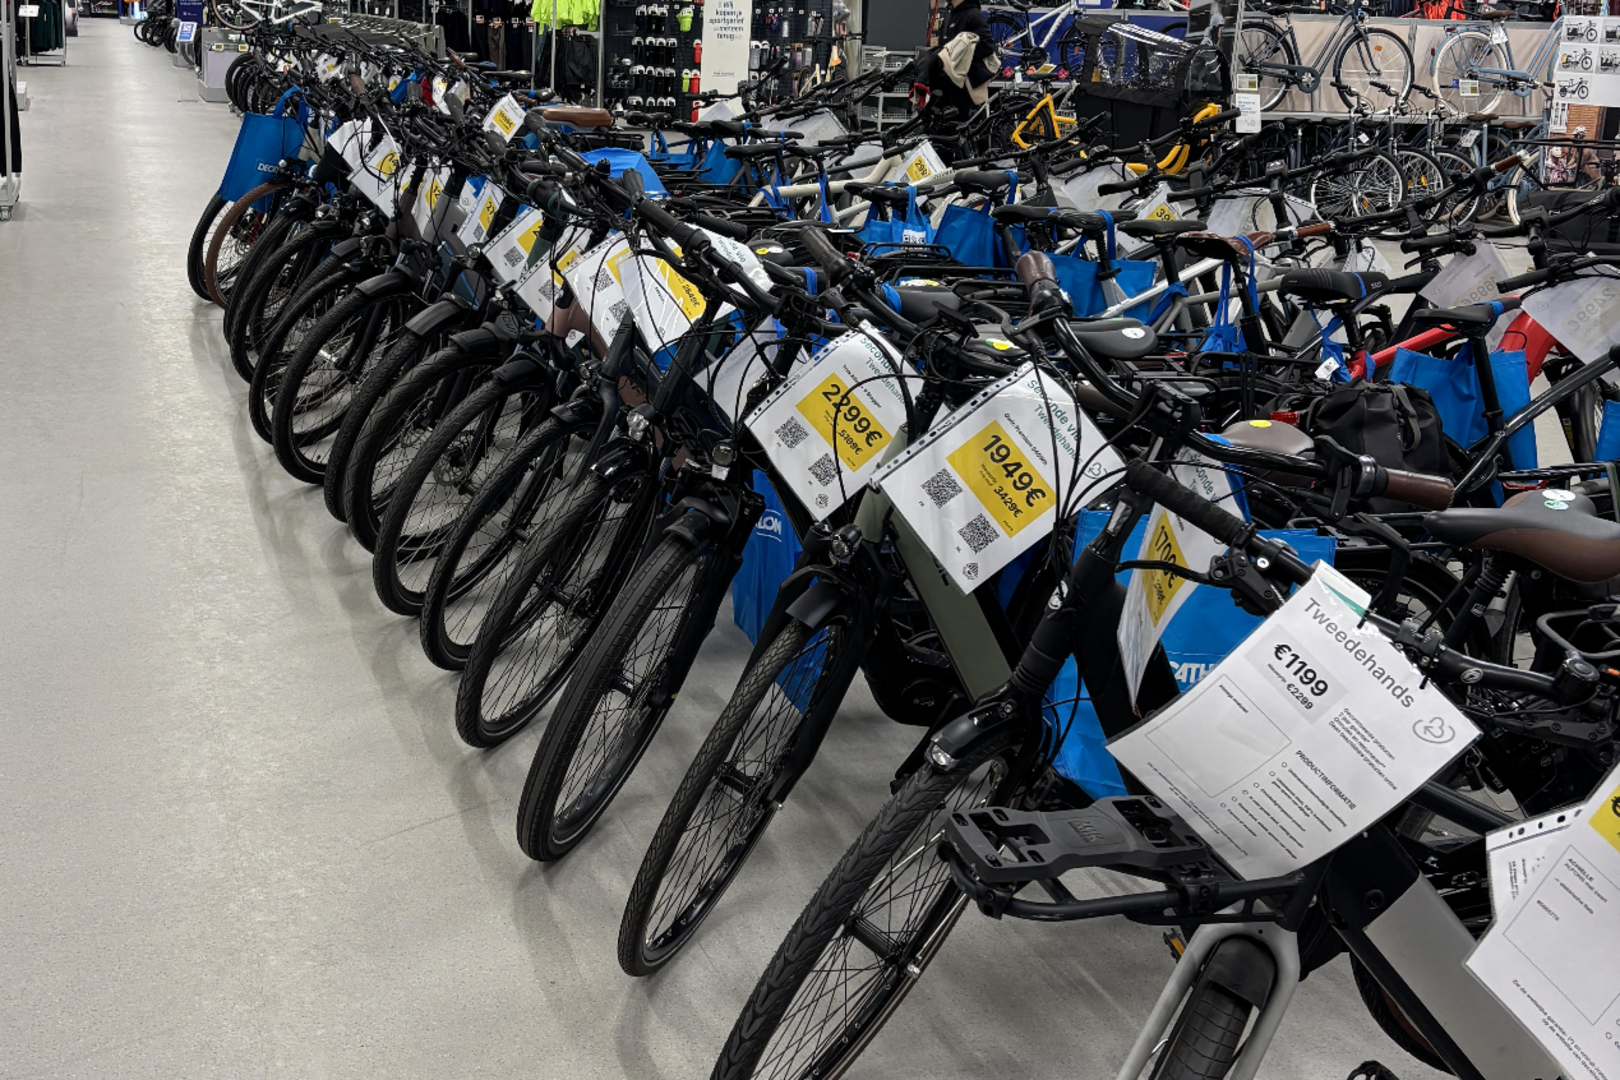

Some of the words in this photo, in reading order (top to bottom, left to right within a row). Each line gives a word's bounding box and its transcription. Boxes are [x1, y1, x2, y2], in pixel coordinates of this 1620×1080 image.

[821, 380, 883, 448] 2299€
[979, 431, 1047, 510] 1949€
[992, 483, 1023, 519] 3429€
[1269, 639, 1331, 700] €1199
[1301, 596, 1418, 709] Tweedehands
[1284, 681, 1314, 712] €2299
[1294, 749, 1357, 811] PRODUCTINFORMATIE
